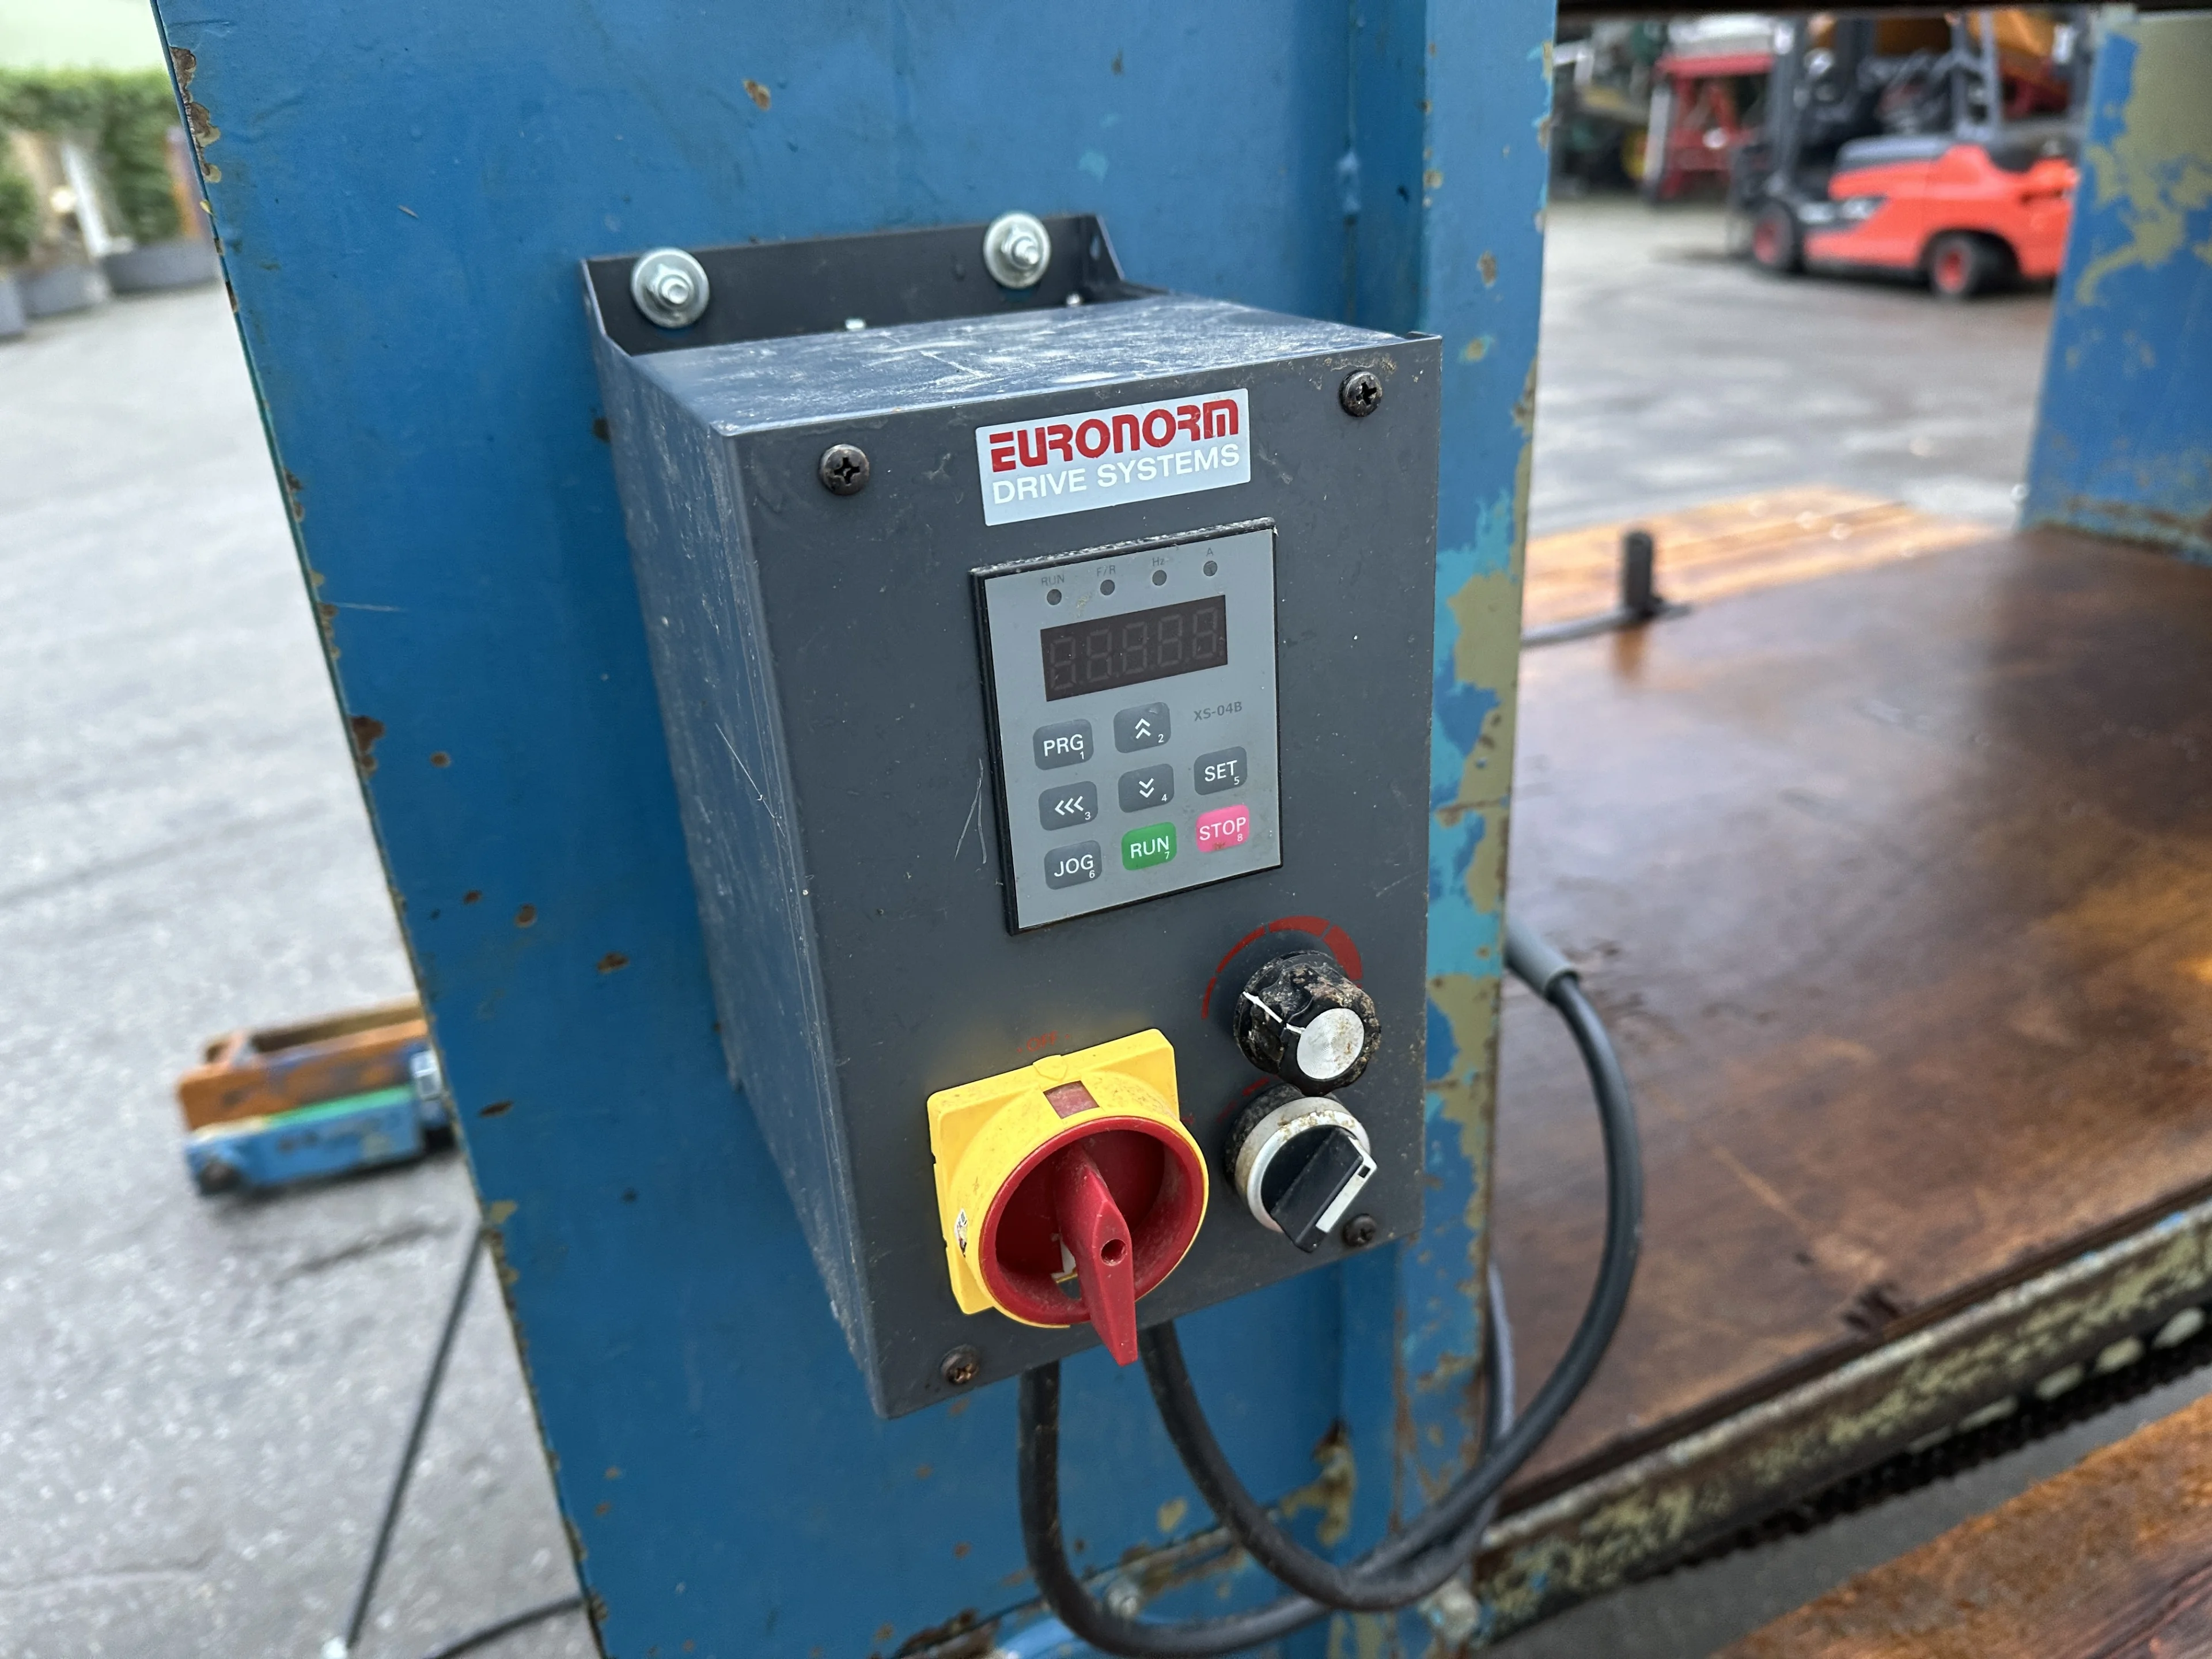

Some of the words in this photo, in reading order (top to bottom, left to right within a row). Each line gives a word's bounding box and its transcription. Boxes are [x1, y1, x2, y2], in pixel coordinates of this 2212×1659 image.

[990, 399, 1238, 472] EURONORM
[993, 468, 1086, 504] DRIVE
[1097, 444, 1240, 488] SYSTEMS
[1206, 547, 1214, 556] A
[1152, 556, 1165, 567] Hz
[1096, 565, 1116, 576] F/R
[1041, 574, 1065, 586] RUN
[1194, 701, 1243, 722] XS-04B
[1158, 734, 1165, 744] 2
[1043, 734, 1084, 757] PRG
[1080, 751, 1085, 760] 1
[1204, 760, 1238, 782] SET
[1233, 776, 1240, 785] 5
[1161, 793, 1168, 802] 4
[1085, 812, 1091, 820] 3
[1199, 817, 1247, 841] STOP
[1237, 834, 1243, 842] 8
[1130, 836, 1170, 859] RUN
[1164, 851, 1170, 860] 7
[1054, 854, 1094, 877] JOG
[1089, 870, 1095, 879] 6
